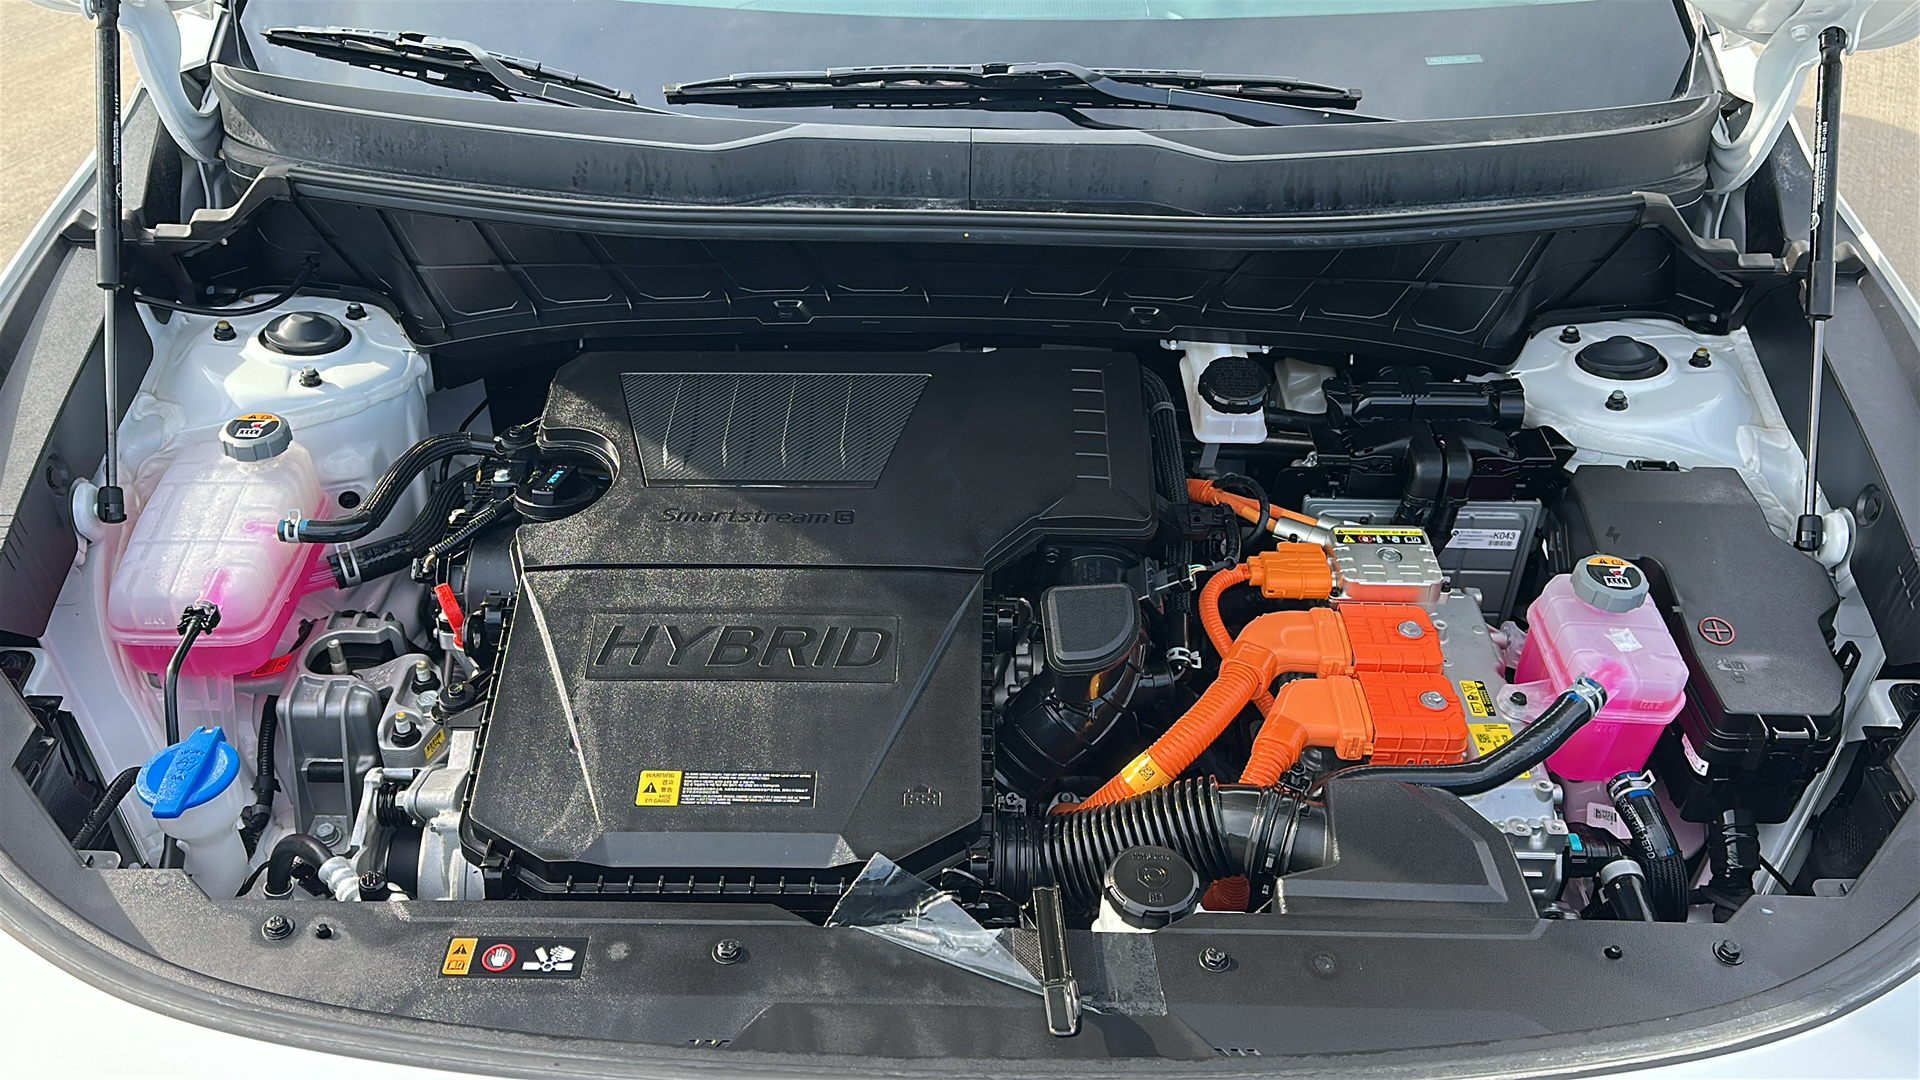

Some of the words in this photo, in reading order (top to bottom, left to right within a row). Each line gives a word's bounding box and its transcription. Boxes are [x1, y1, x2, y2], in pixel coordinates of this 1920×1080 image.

[659, 508, 831, 524] Smartstream
[1493, 532, 1516, 540] K043
[593, 625, 893, 667] HYBRID
